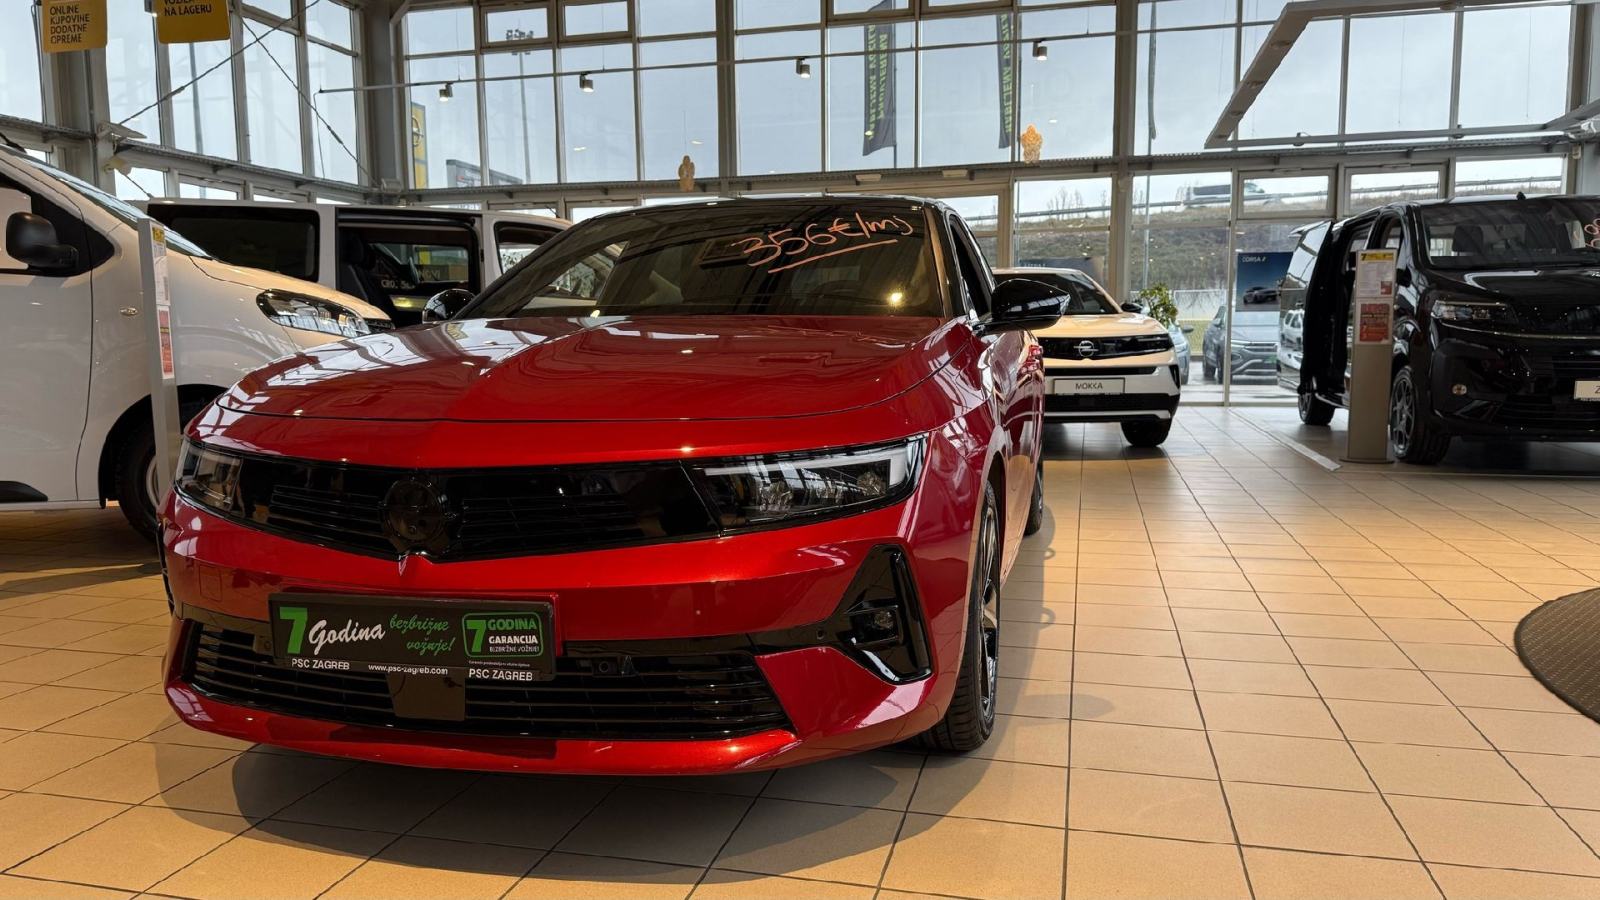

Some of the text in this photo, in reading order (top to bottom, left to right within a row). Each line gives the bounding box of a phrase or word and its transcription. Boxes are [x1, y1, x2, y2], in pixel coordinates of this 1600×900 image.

[50, 5, 80, 16] ONLINE
[164, 4, 212, 17] NA LAGERU
[50, 24, 88, 34] DODATNE
[50, 34, 82, 44] OPREME
[1075, 382, 1103, 390] MOKKA
[389, 613, 450, 635] bezbrižne
[487, 618, 537, 630] GODINA
[279, 606, 386, 655] 7 Godina
[466, 619, 486, 653] 7
[488, 635, 539, 644] GARANCIJA
[291, 658, 350, 670] PSC ZAGREB
[368, 664, 448, 675] www.psc-zagreb.com
[468, 668, 533, 681] PSC ZAGREB
